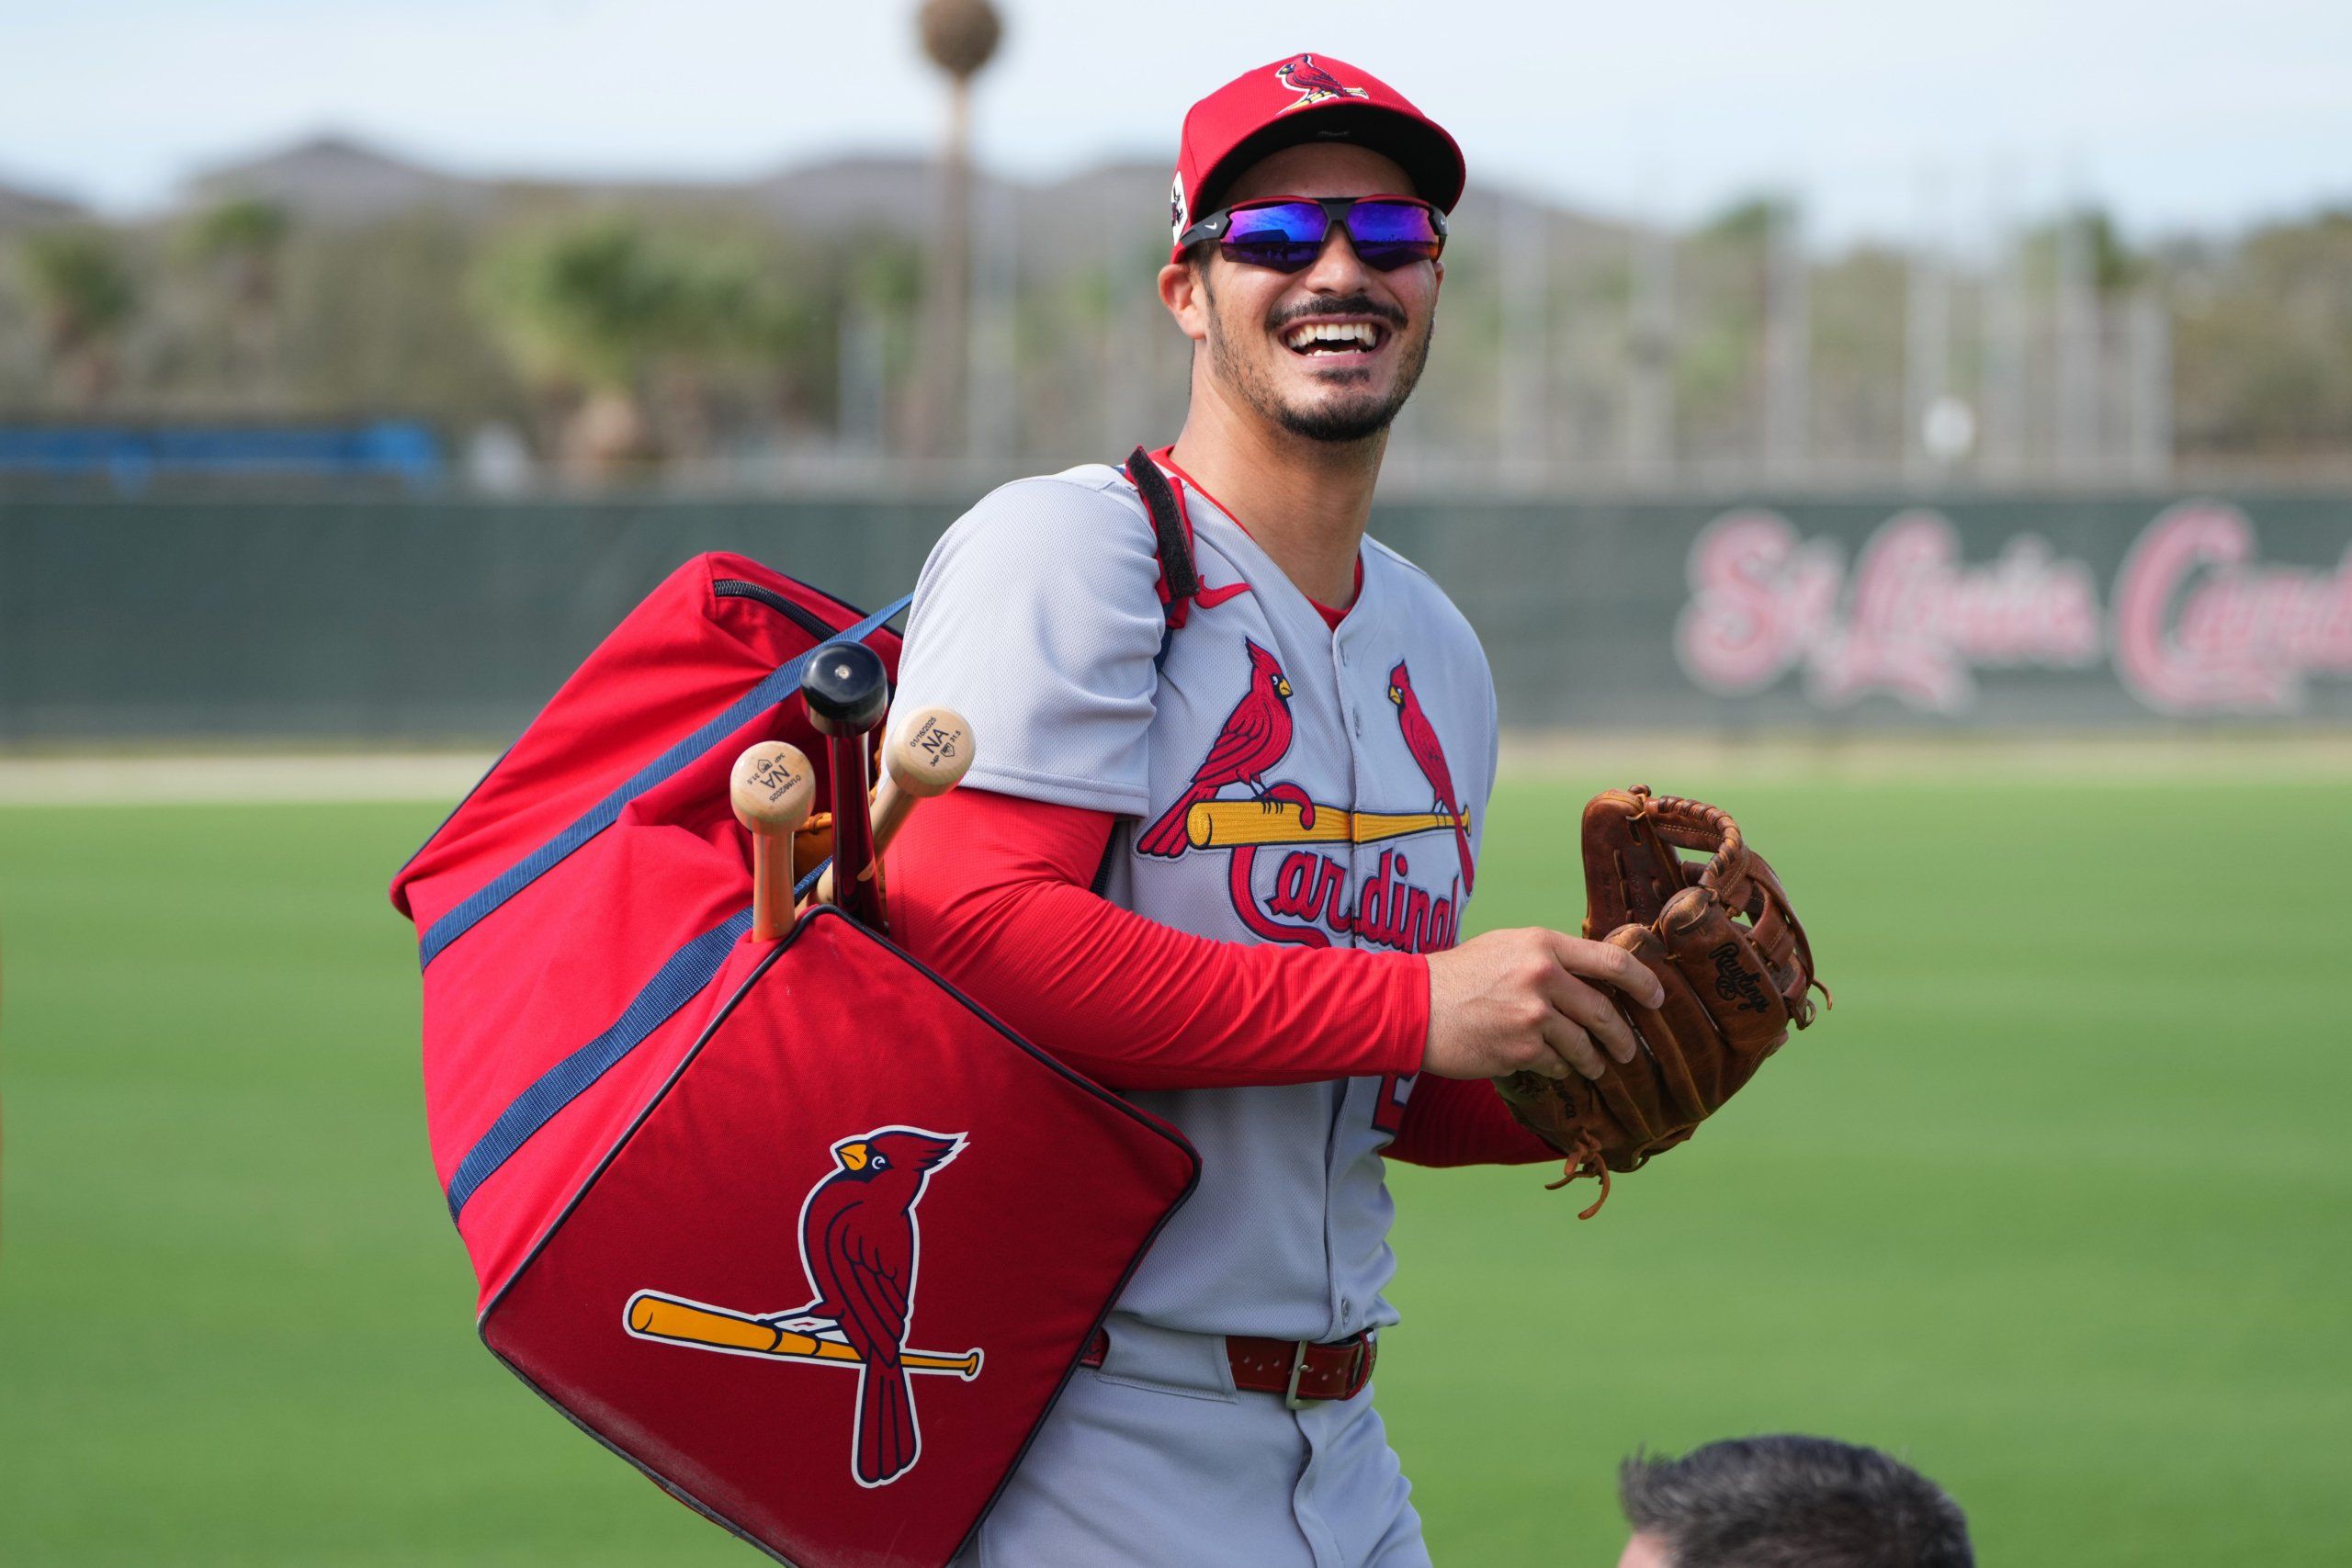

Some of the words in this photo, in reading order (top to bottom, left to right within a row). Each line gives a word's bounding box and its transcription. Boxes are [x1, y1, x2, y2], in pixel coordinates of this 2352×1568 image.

[922, 729, 949, 753] NA
[950, 729, 961, 742] 31.5
[747, 773, 760, 784] 31.5
[760, 764, 790, 789] NA
[1707, 942, 1770, 1013] Rawlings
